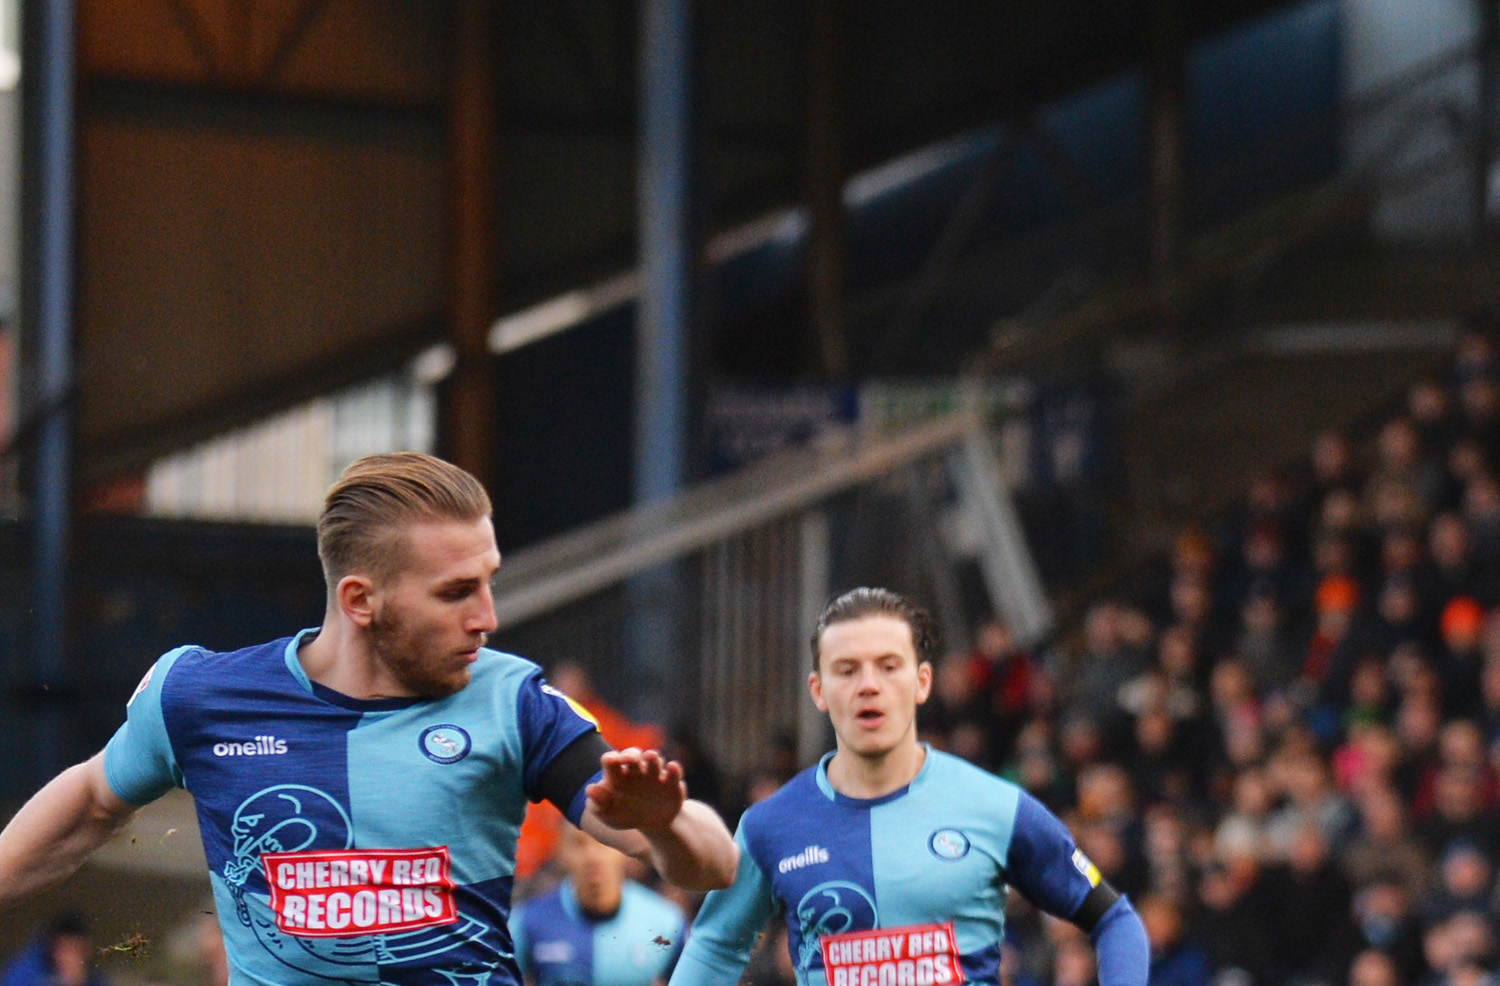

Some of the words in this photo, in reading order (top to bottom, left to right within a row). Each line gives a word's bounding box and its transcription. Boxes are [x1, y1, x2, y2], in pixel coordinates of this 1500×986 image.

[213, 735, 288, 757] oneills
[277, 860, 387, 890] CHERRY
[392, 857, 442, 885] RED
[779, 844, 830, 874] oneills
[283, 886, 444, 929] RECORDS
[828, 934, 904, 966] CHERRY
[908, 930, 949, 957] RED
